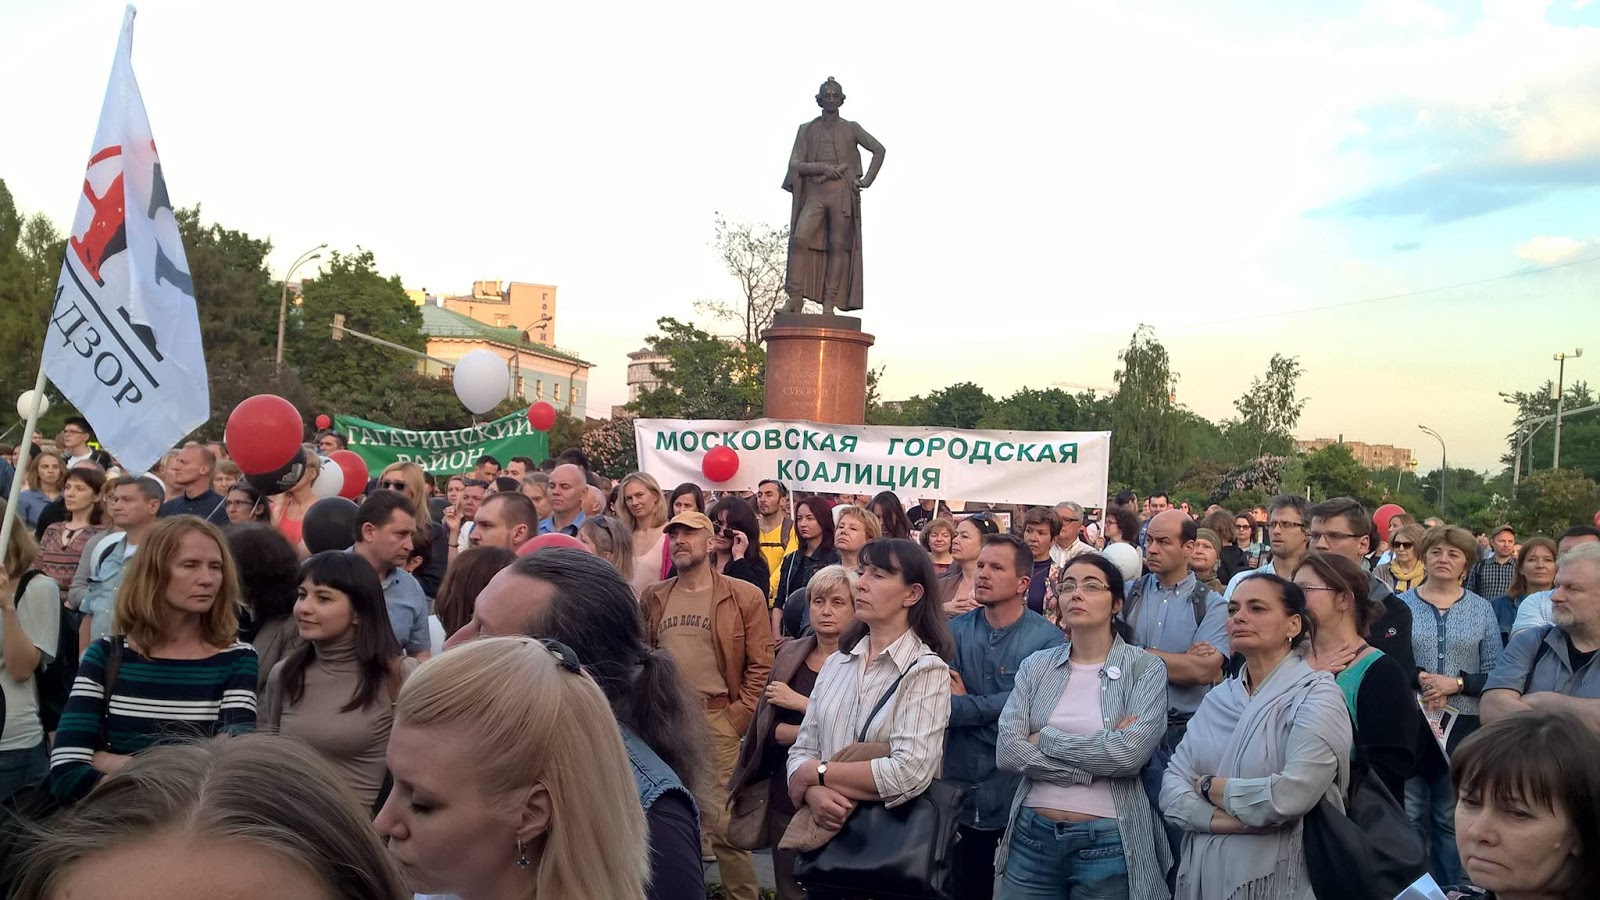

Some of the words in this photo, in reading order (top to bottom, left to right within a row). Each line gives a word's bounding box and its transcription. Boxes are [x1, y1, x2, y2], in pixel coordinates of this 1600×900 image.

[655, 428, 858, 452] МОСКОВСКАЯ
[887, 437, 1078, 465] ГОРОДСКАЯ
[777, 459, 941, 491] КОАЛИЦИЯ
[680, 614, 702, 627] ROCK
